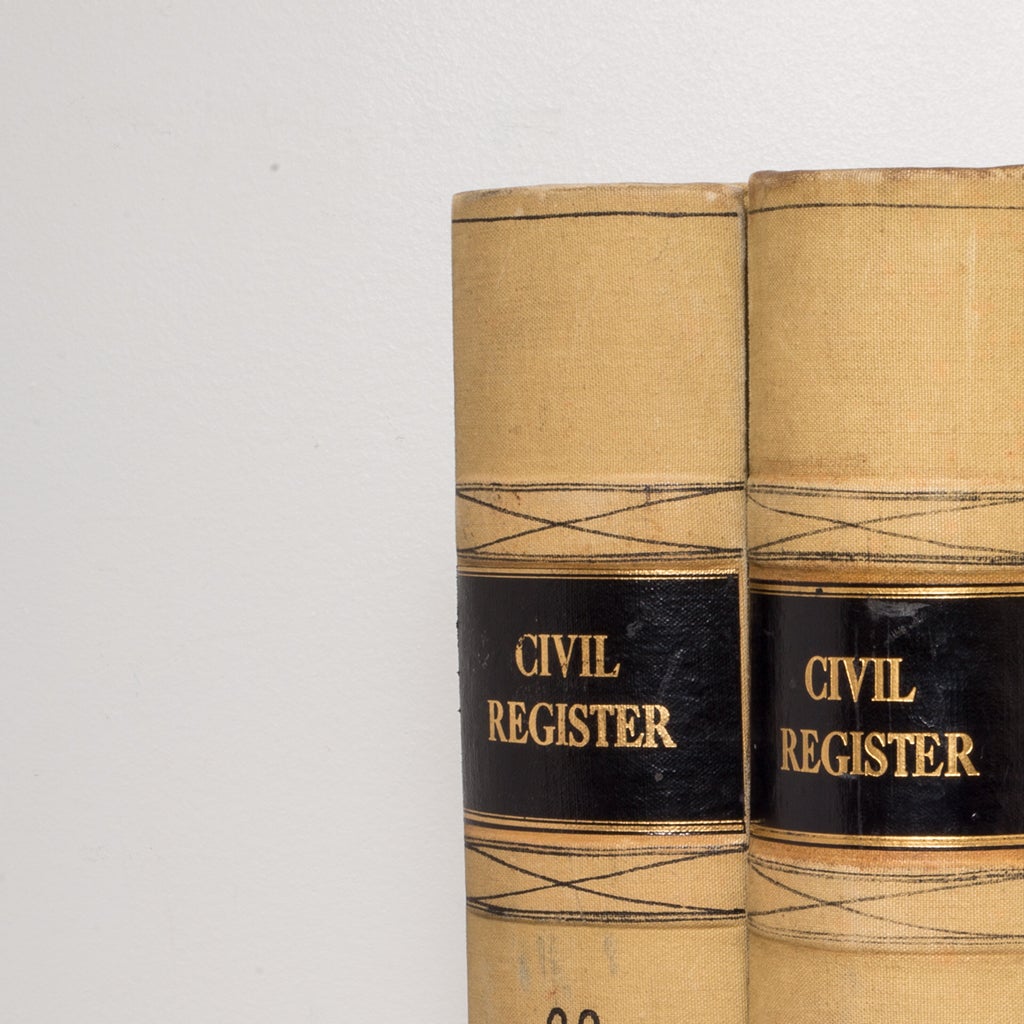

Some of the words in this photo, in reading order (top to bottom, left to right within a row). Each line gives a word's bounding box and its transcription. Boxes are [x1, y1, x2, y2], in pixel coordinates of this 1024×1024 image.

[514, 633, 621, 678] CIVIL
[804, 656, 917, 703] CIVIL
[487, 700, 677, 748] REGISTER
[780, 728, 980, 777] REGISTER
